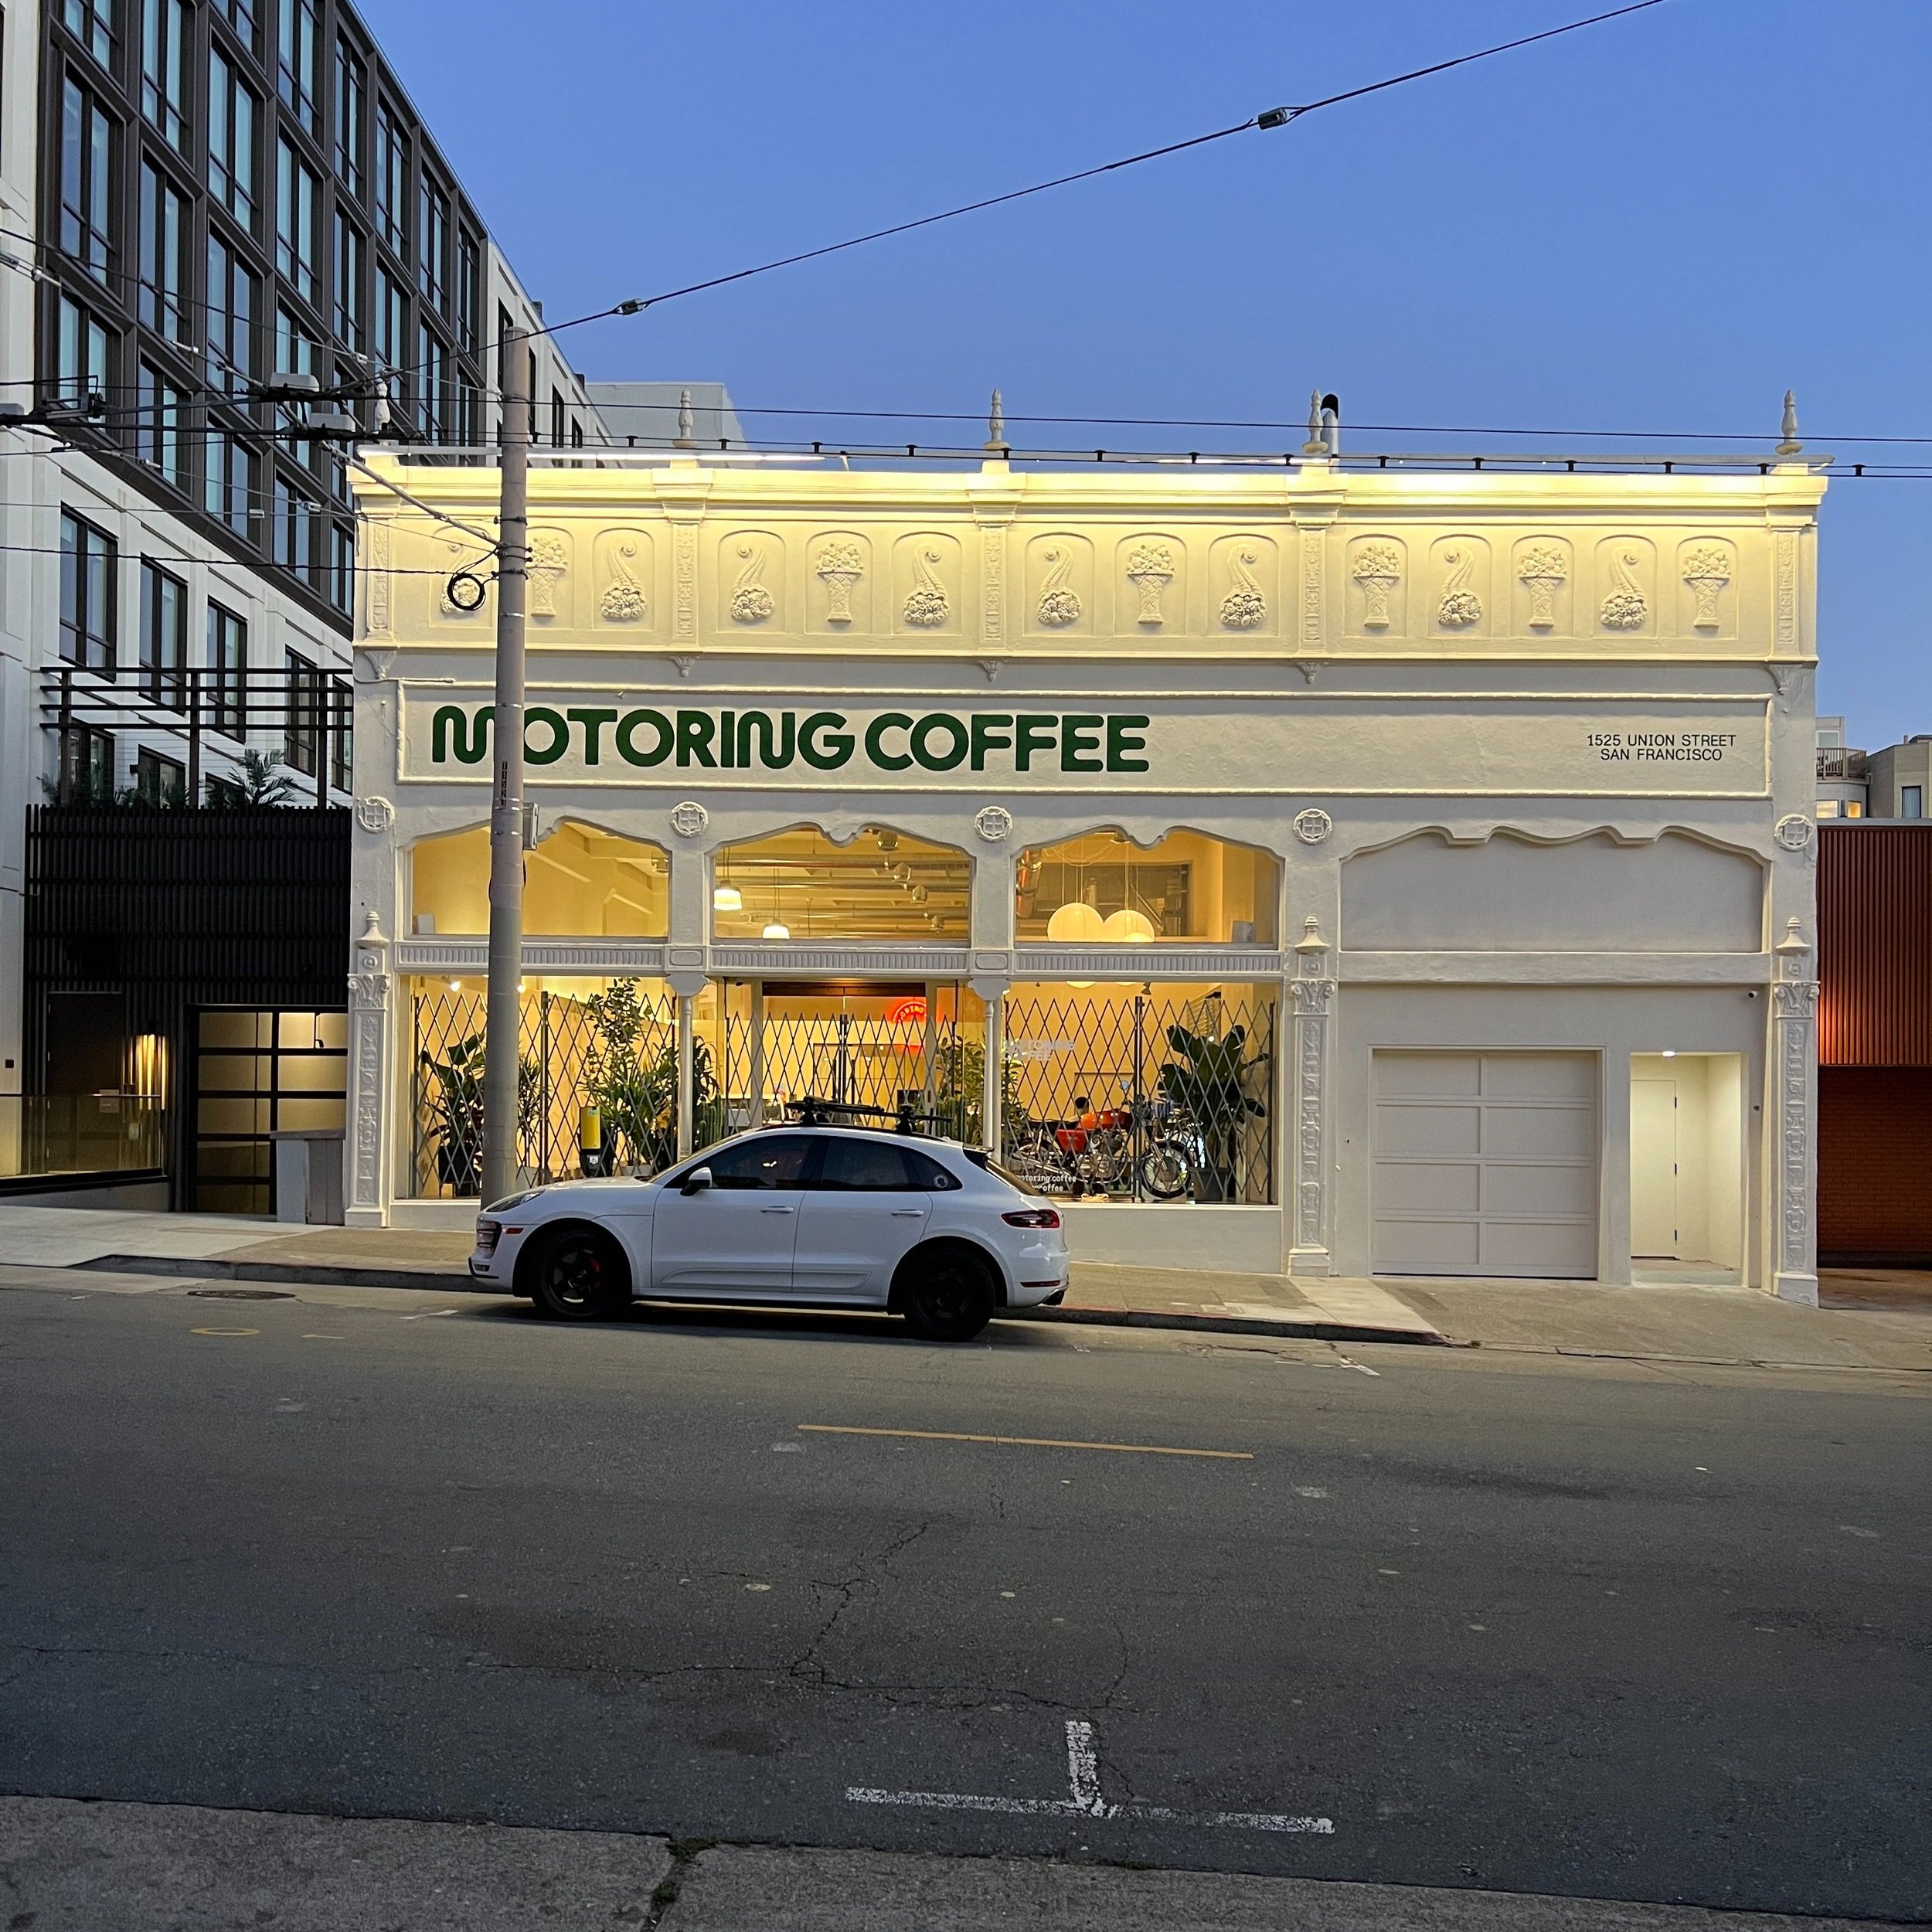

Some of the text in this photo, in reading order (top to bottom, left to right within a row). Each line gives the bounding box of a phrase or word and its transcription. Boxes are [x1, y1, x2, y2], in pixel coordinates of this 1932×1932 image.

[432, 706, 1150, 772] MOTORING COFFEE
[1587, 734, 1736, 747] 1525 UNION STREET
[1600, 748, 1723, 760] SAN FRANCISCO
